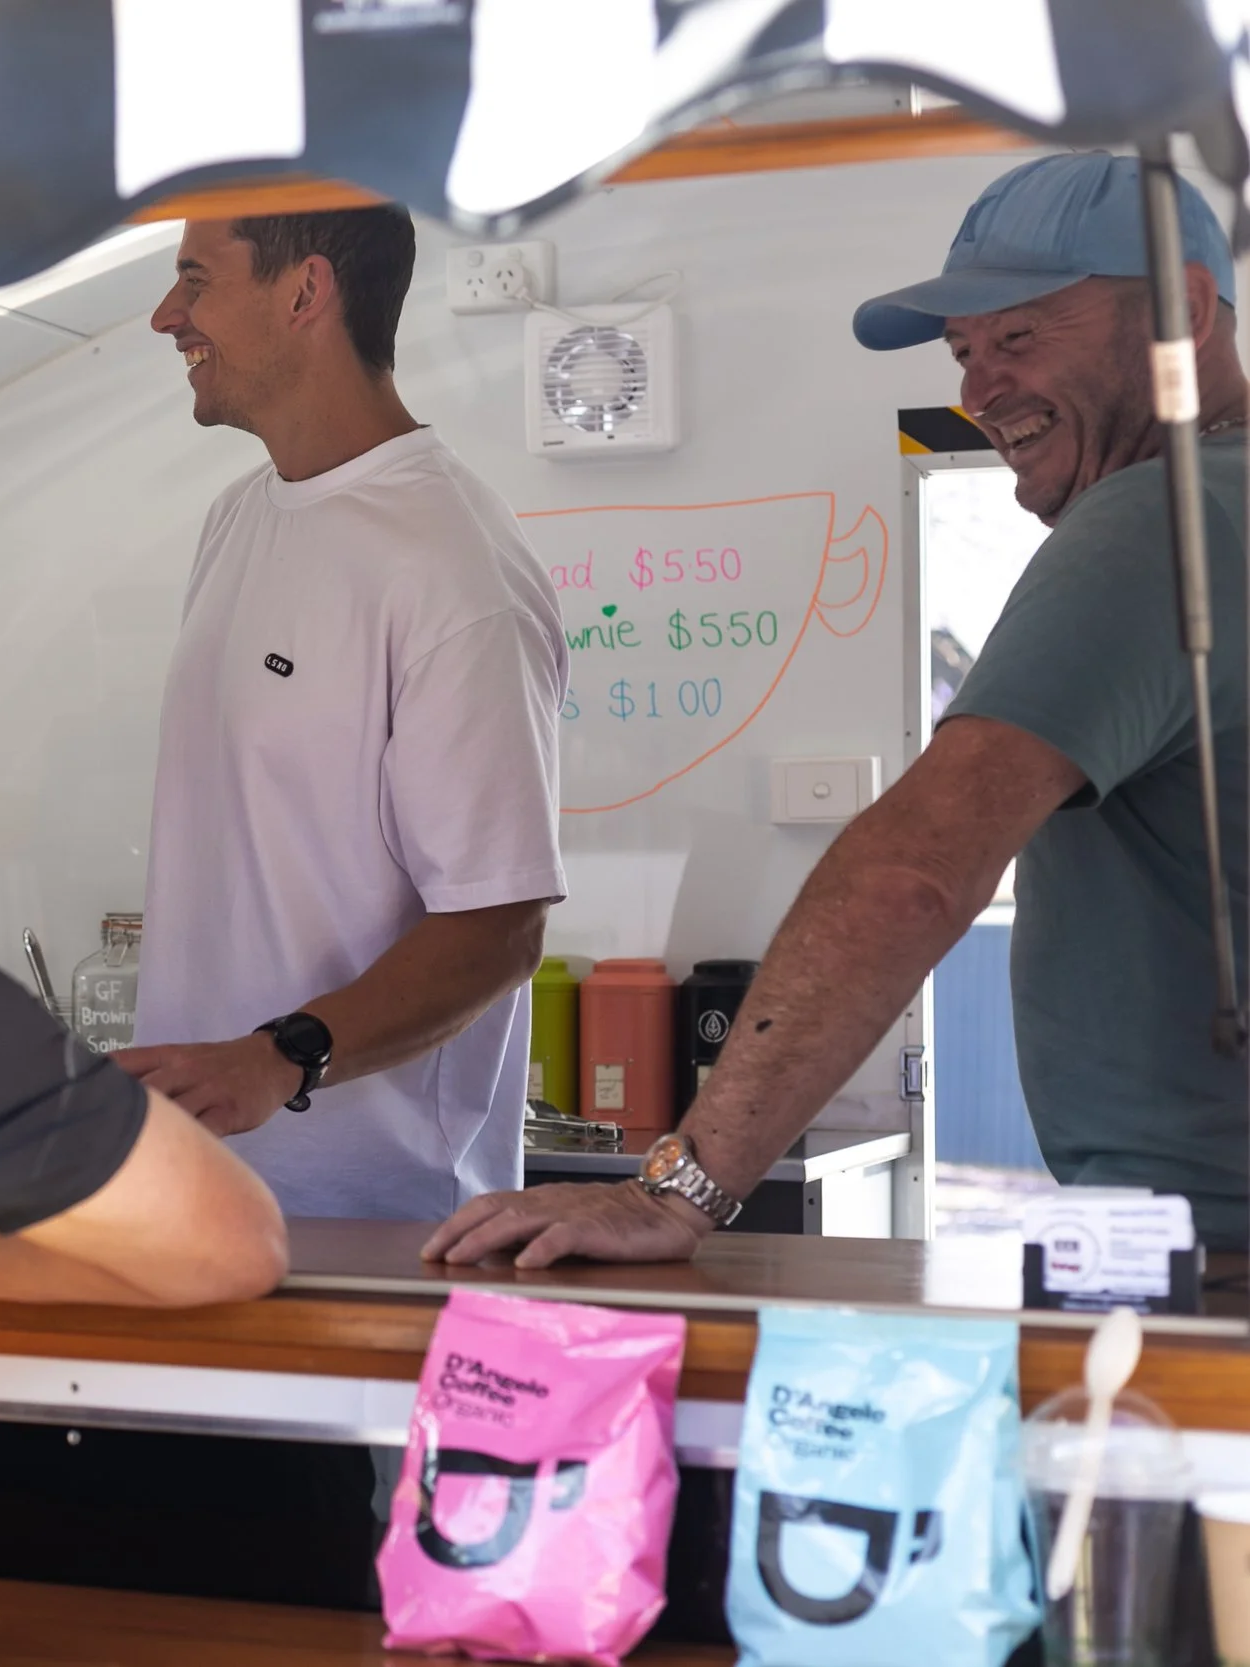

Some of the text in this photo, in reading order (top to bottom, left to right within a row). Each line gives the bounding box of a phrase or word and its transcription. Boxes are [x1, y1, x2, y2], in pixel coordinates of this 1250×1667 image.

[94, 980, 123, 1002] GF
[439, 1372, 517, 1408] Coffee
[445, 1352, 550, 1399] D'Angelo
[431, 1390, 517, 1429] Oganic
